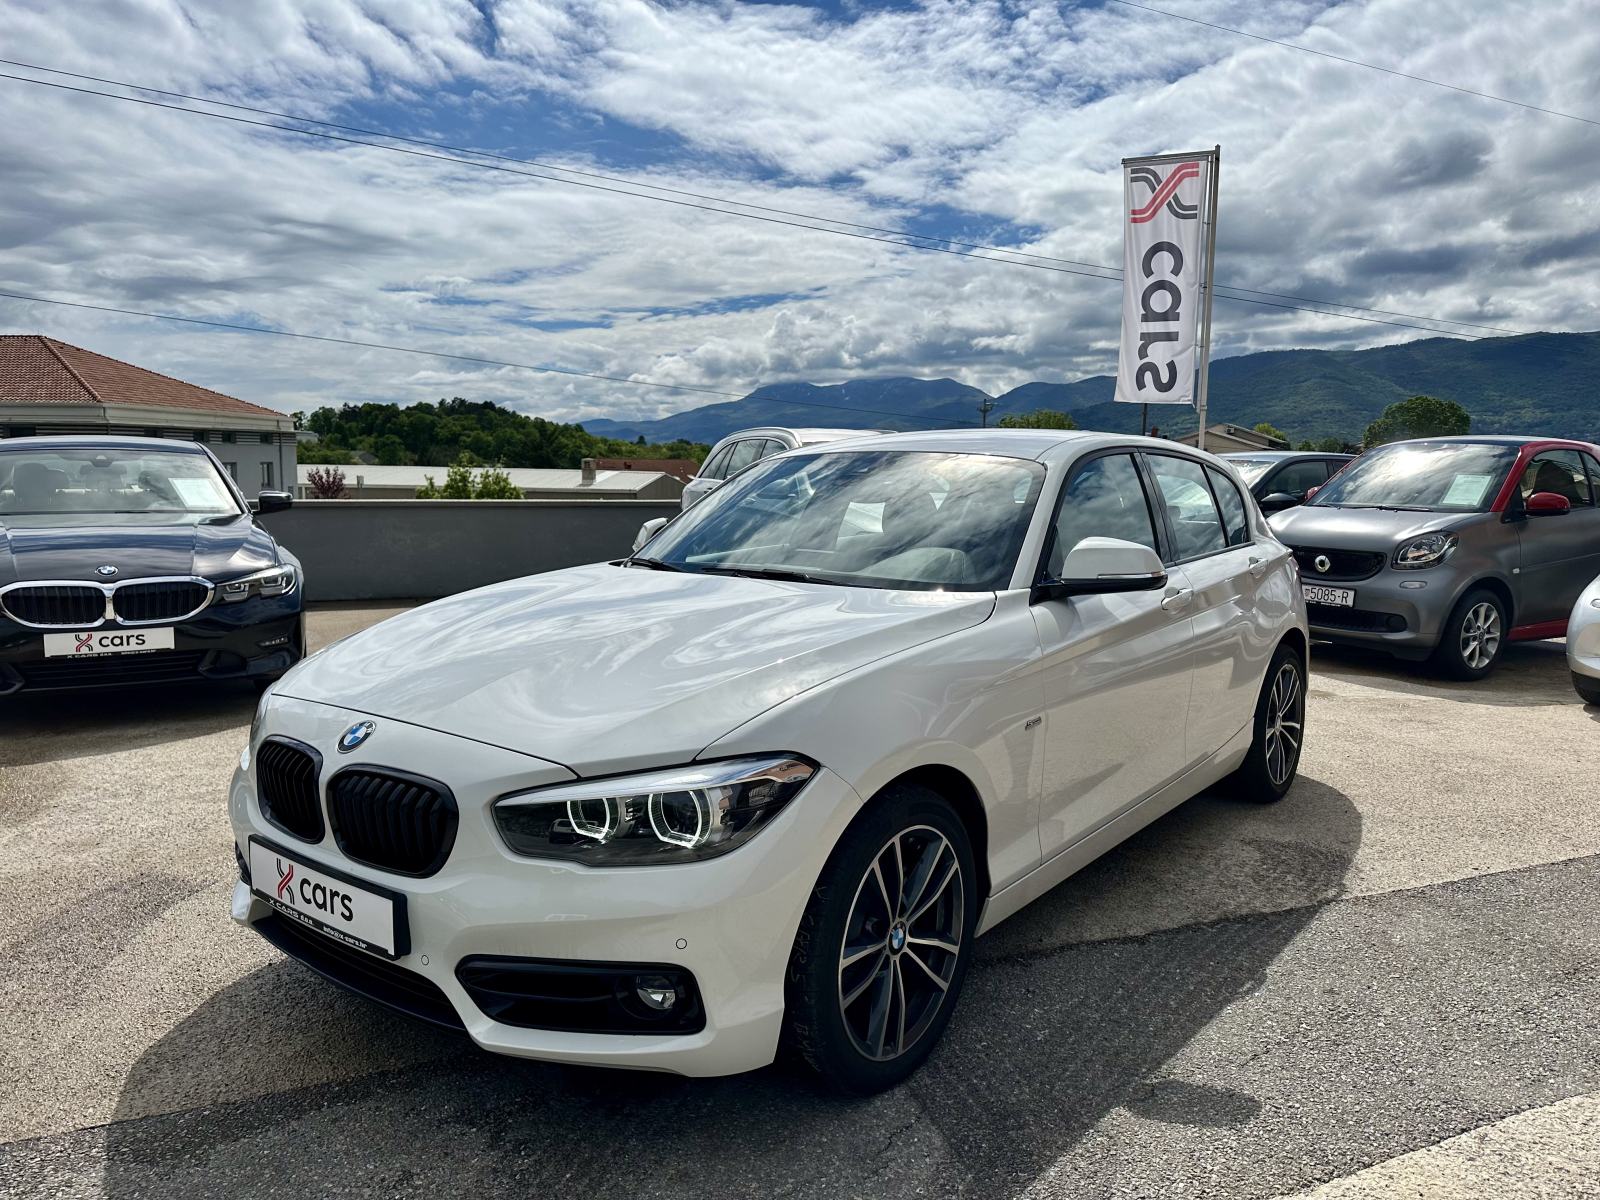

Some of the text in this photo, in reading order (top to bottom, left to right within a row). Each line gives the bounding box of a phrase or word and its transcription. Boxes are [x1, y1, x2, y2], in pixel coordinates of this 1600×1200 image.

[1310, 587, 1349, 604] 5085-R
[99, 633, 146, 648] cars
[299, 877, 354, 922] cars
[275, 902, 300, 919] CARS
